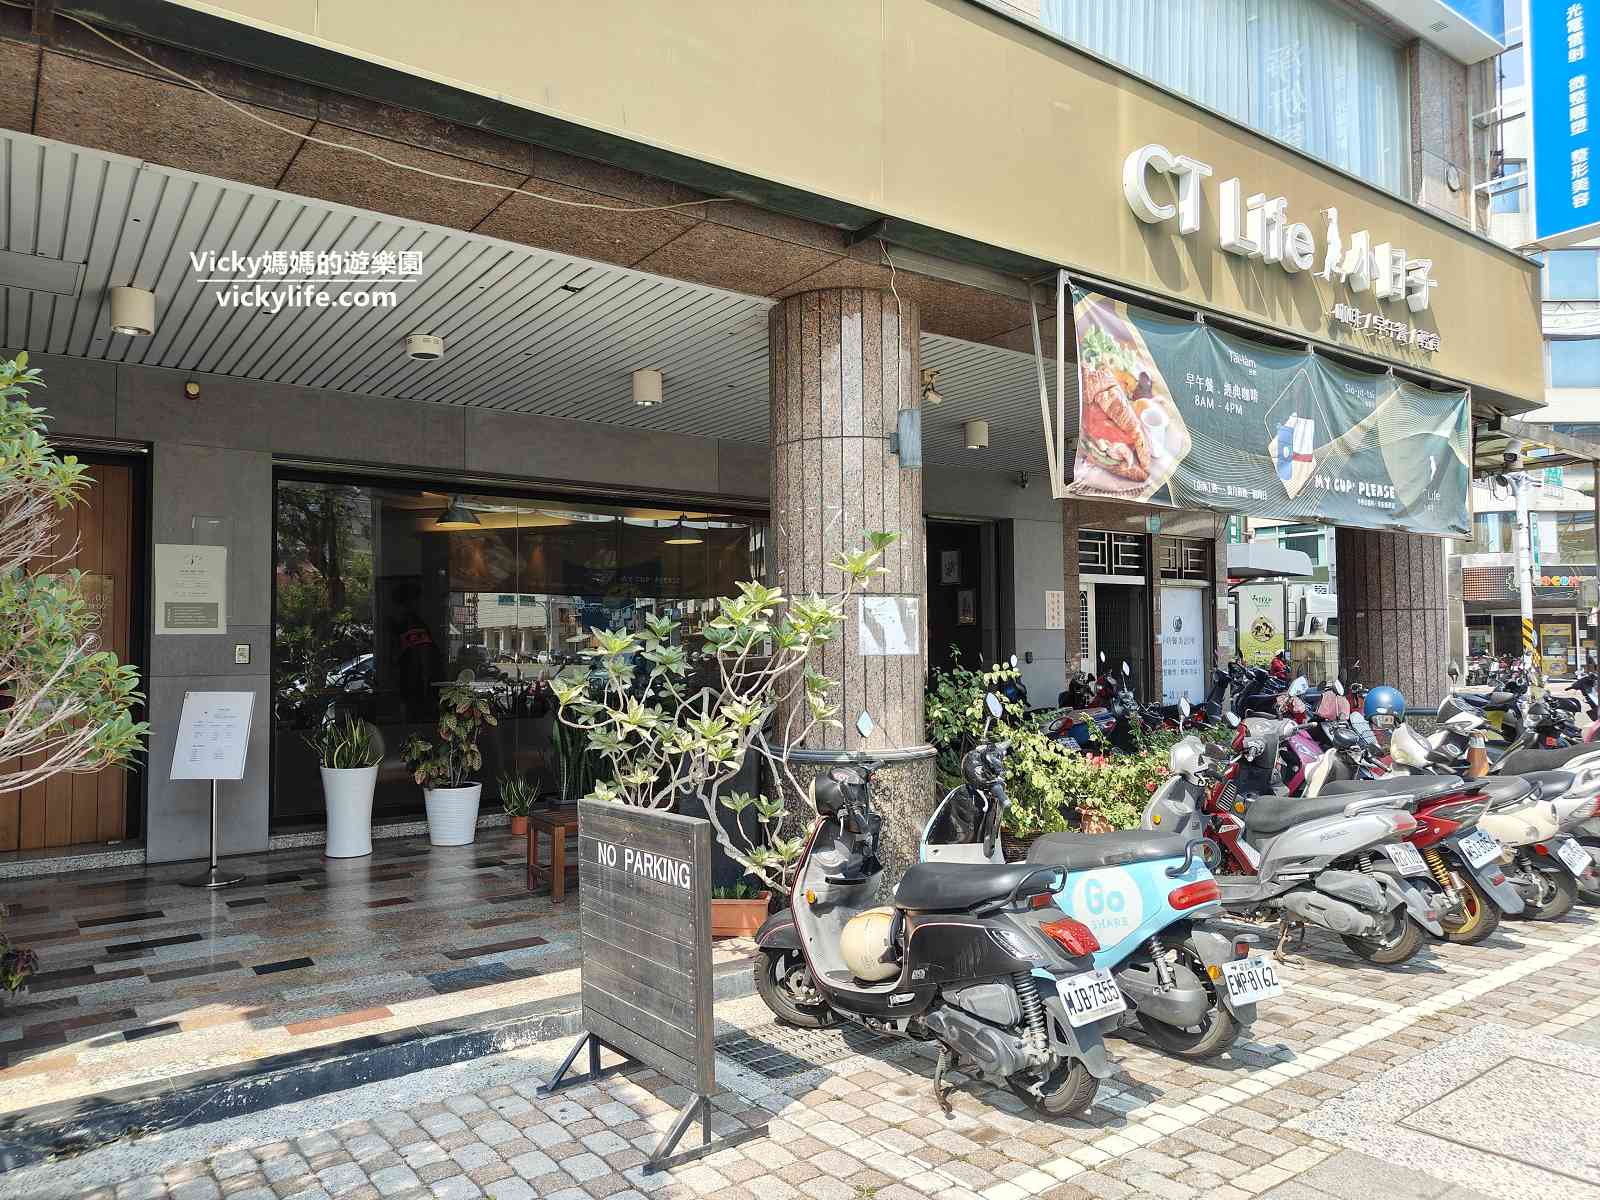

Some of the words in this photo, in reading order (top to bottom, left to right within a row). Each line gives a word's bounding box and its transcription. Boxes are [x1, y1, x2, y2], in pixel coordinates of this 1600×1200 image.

[1123, 144, 1213, 235] CT
[1219, 177, 1315, 274] Life
[1337, 229, 1439, 313] 小日子
[1194, 394, 1215, 409] 8AM
[1224, 401, 1243, 416] 4PM
[1315, 474, 1331, 490] MY
[1358, 482, 1395, 499] PLEASE
[597, 841, 617, 868] NO
[624, 848, 691, 890] PARKING
[1084, 878, 1125, 915] Go
[1063, 979, 1120, 1017] MJB-7355
